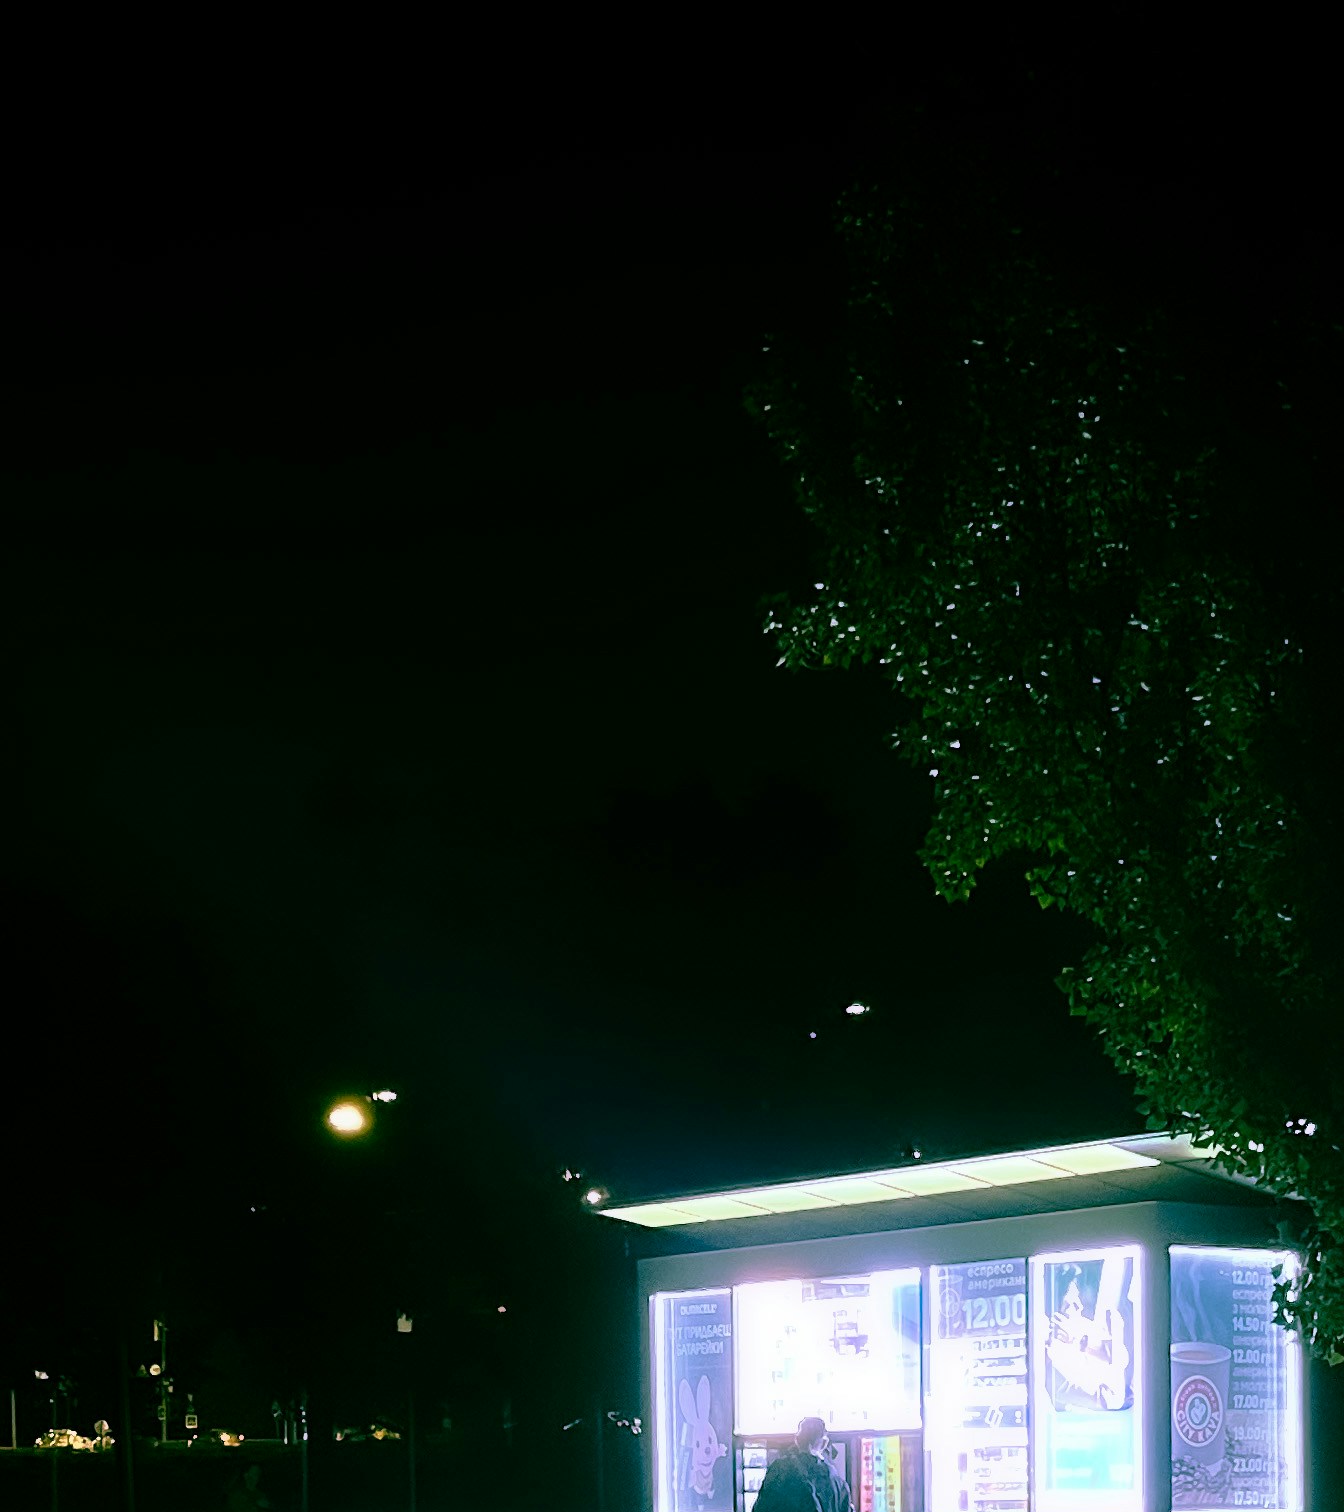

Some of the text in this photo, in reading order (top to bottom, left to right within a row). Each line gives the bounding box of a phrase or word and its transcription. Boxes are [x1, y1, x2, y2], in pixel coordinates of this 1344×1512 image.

[967, 1263, 1014, 1278] еспресо
[1232, 1270, 1259, 1286] 12.00
[961, 1293, 1026, 1330] 12.00
[1232, 1349, 1260, 1364] 12.00
[1233, 1394, 1259, 1409] 17.00
